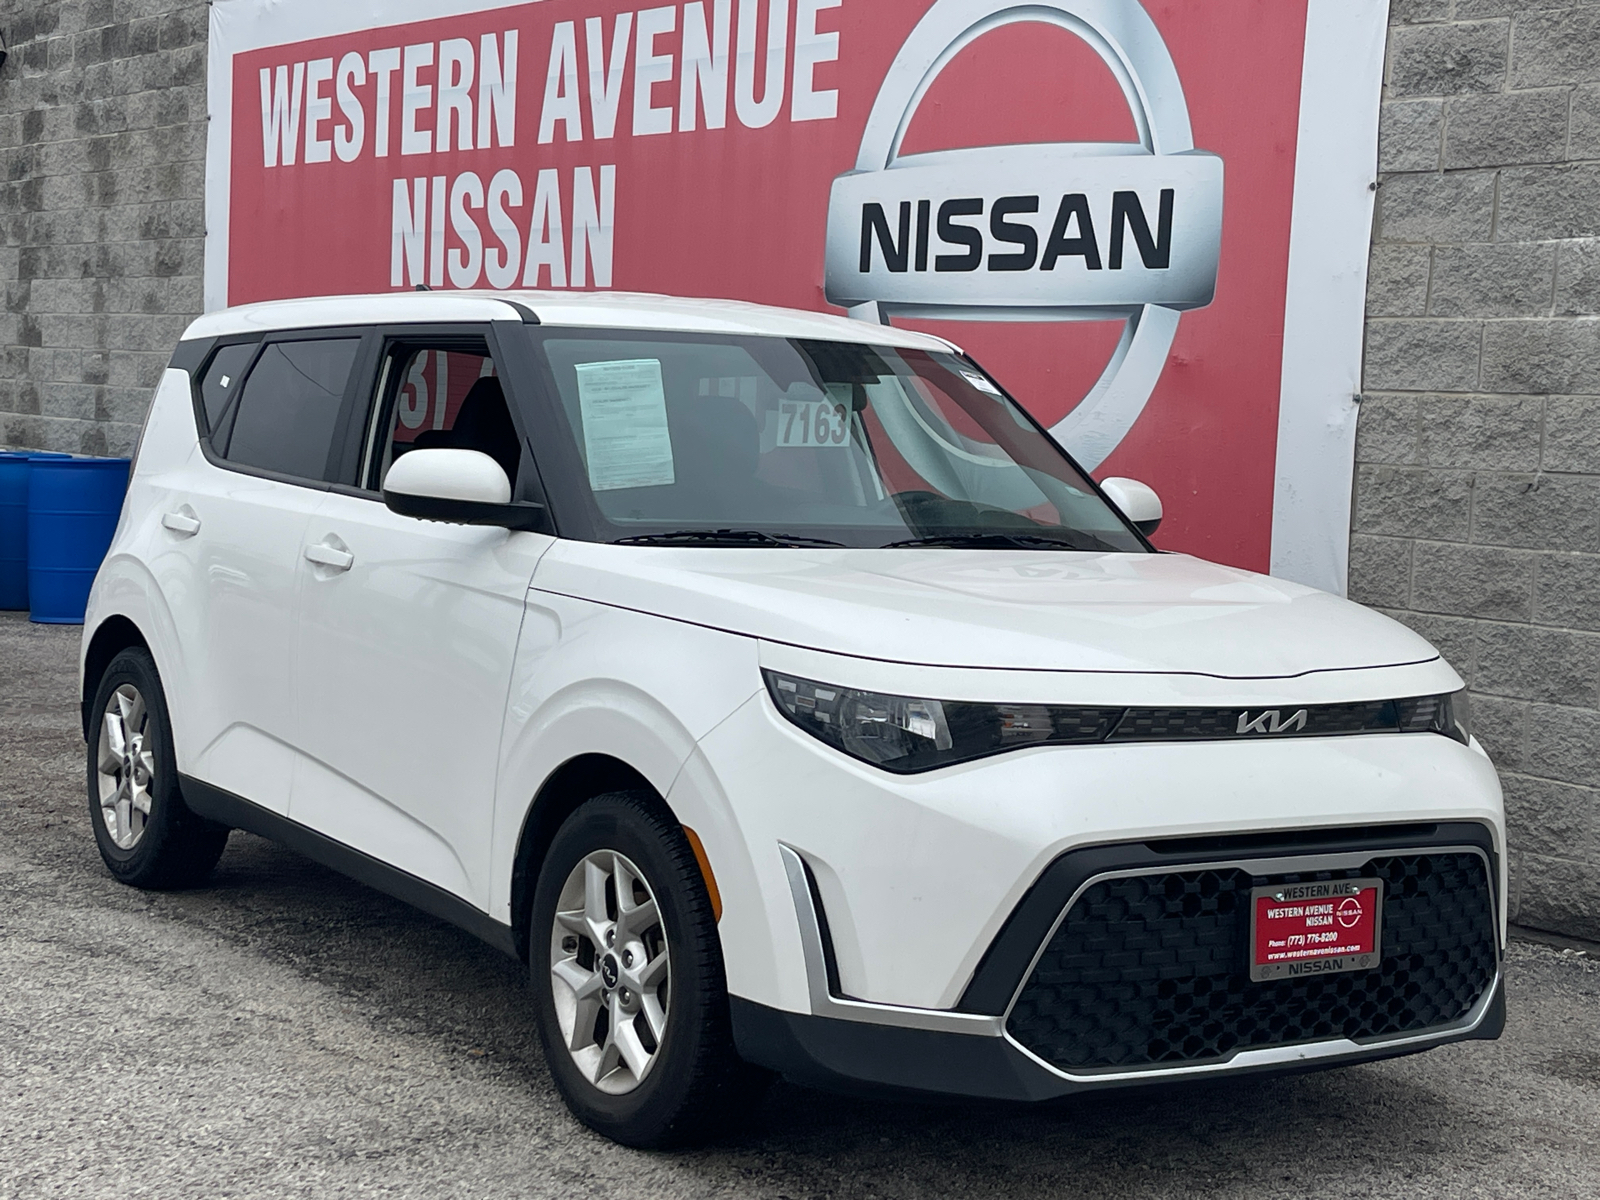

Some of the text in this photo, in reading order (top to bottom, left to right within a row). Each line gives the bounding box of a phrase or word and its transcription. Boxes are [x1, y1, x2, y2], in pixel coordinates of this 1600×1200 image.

[259, 0, 842, 168] WESTERN AVENUE
[390, 164, 617, 289] NISSAN
[859, 188, 1175, 273] NISSAN
[781, 403, 848, 445] 7163
[1283, 884, 1330, 900] WESTERN
[1267, 904, 1334, 919] WESTERN AVENUE
[1306, 915, 1333, 927] NISSAN
[1268, 931, 1338, 948] Phone: (773) 776-8200
[1288, 959, 1343, 975] NISSAN
